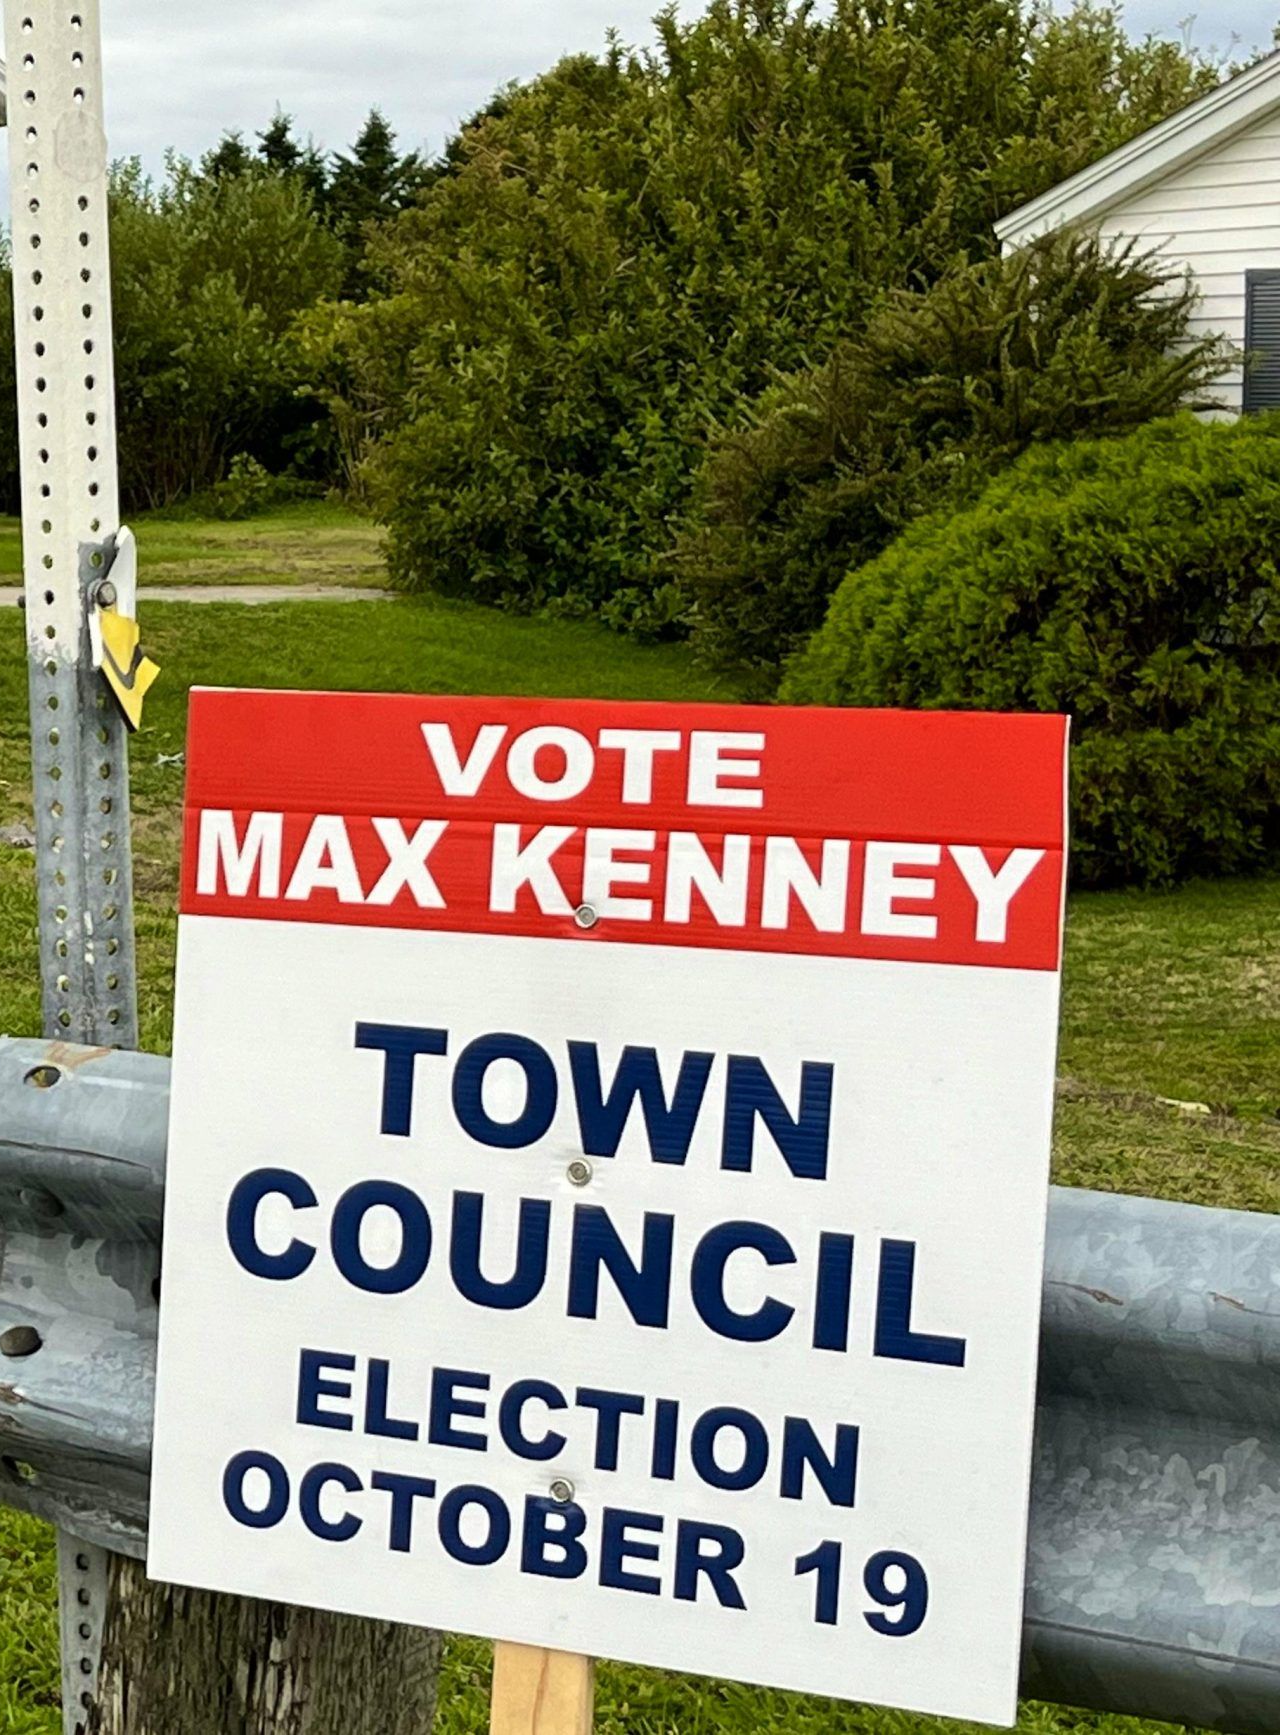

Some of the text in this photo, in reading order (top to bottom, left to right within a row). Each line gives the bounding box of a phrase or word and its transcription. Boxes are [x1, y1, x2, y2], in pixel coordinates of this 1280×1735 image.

[421, 722, 765, 809] VOTE
[194, 808, 1045, 944] MAX KENNEY
[355, 1021, 836, 1182] TOWN
[225, 1167, 968, 1369] COUNCIL
[295, 1347, 862, 1510] ELECTION
[221, 1449, 931, 1639] OCTOBER 19
